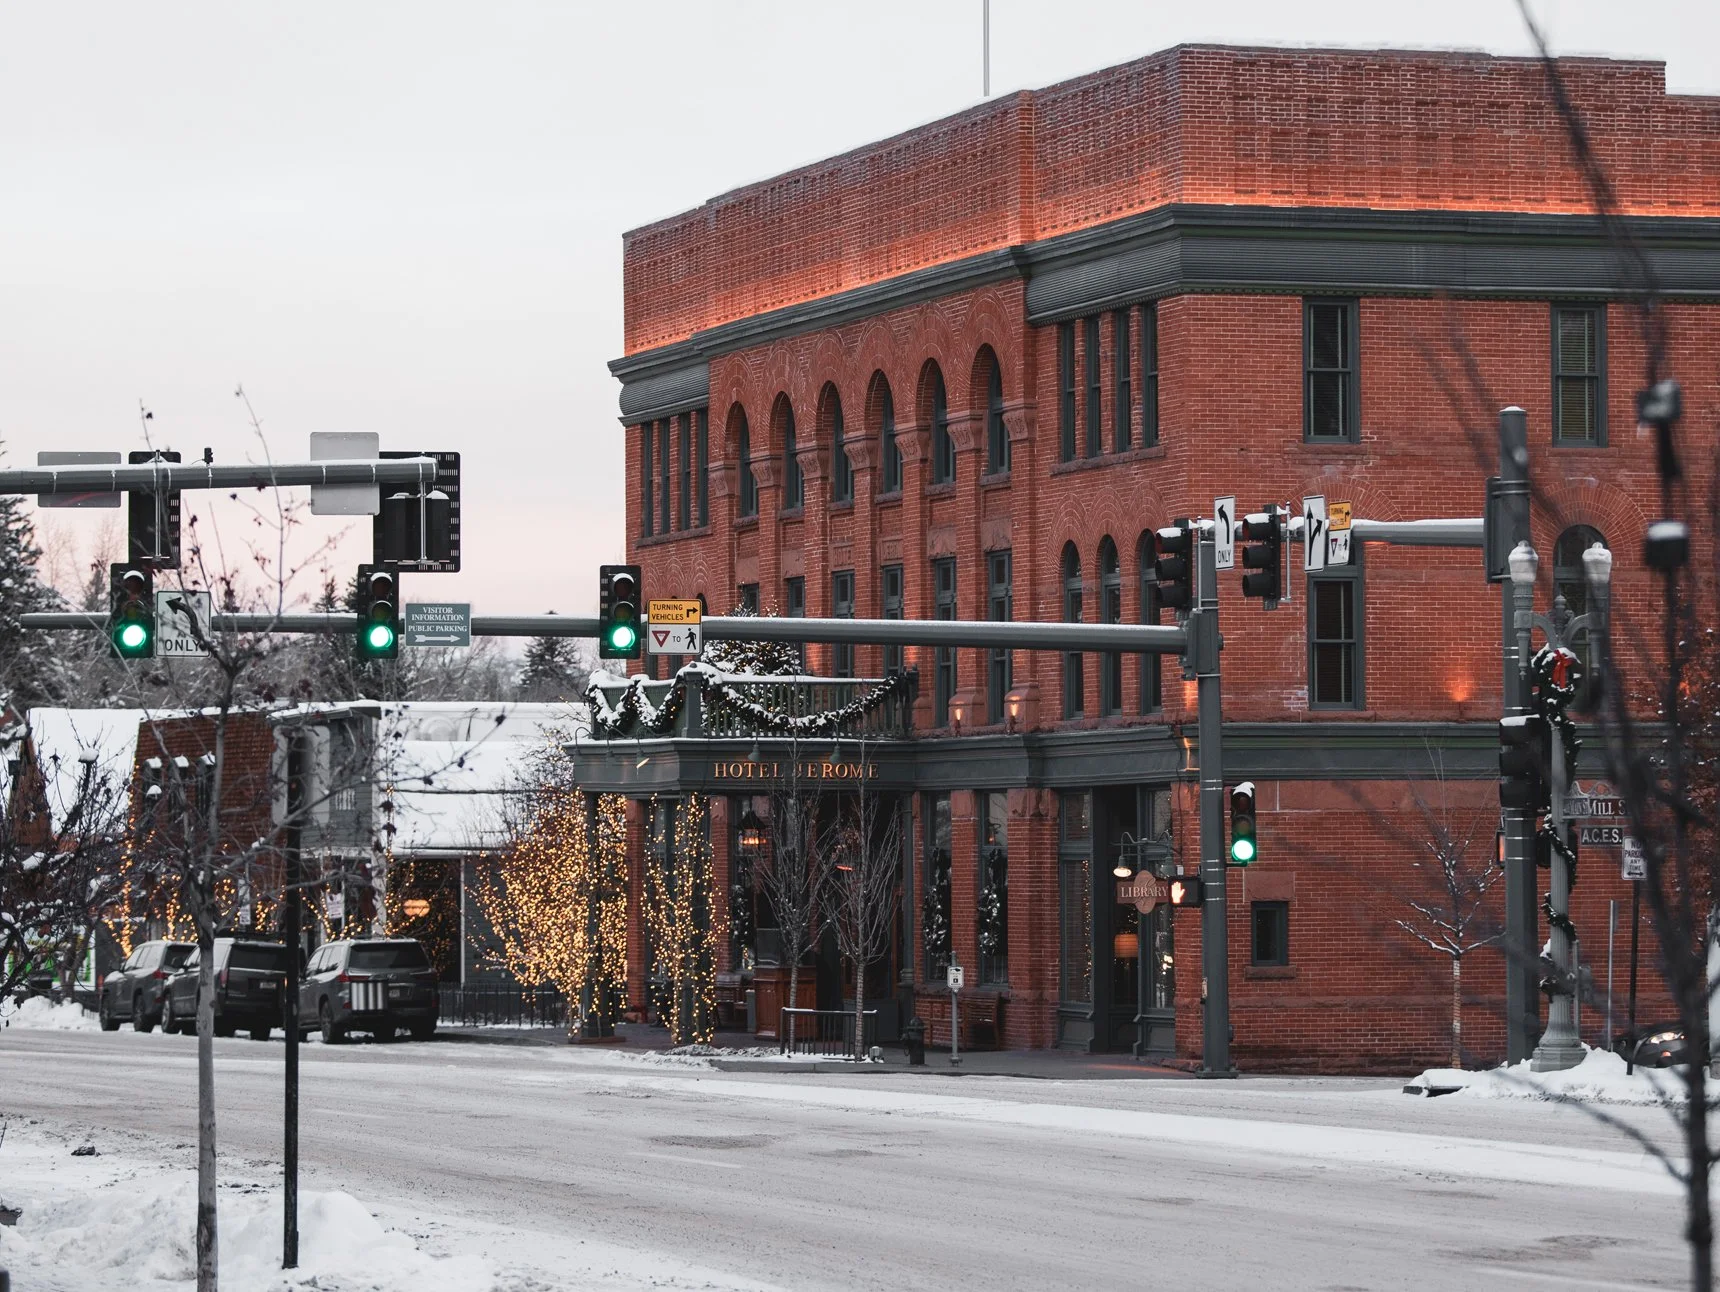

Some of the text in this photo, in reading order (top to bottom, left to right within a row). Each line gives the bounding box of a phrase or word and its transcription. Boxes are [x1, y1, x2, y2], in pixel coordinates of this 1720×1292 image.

[1218, 549, 1231, 563] ONLY
[423, 606, 453, 614] VISITOR
[165, 639, 200, 652] ONLY
[672, 635, 682, 643] TO
[714, 762, 879, 779] HOTEL JEROME
[1589, 800, 1615, 815] MILL
[1582, 828, 1622, 843] A.C.E.S.
[1121, 886, 1168, 897] LIBRARY
